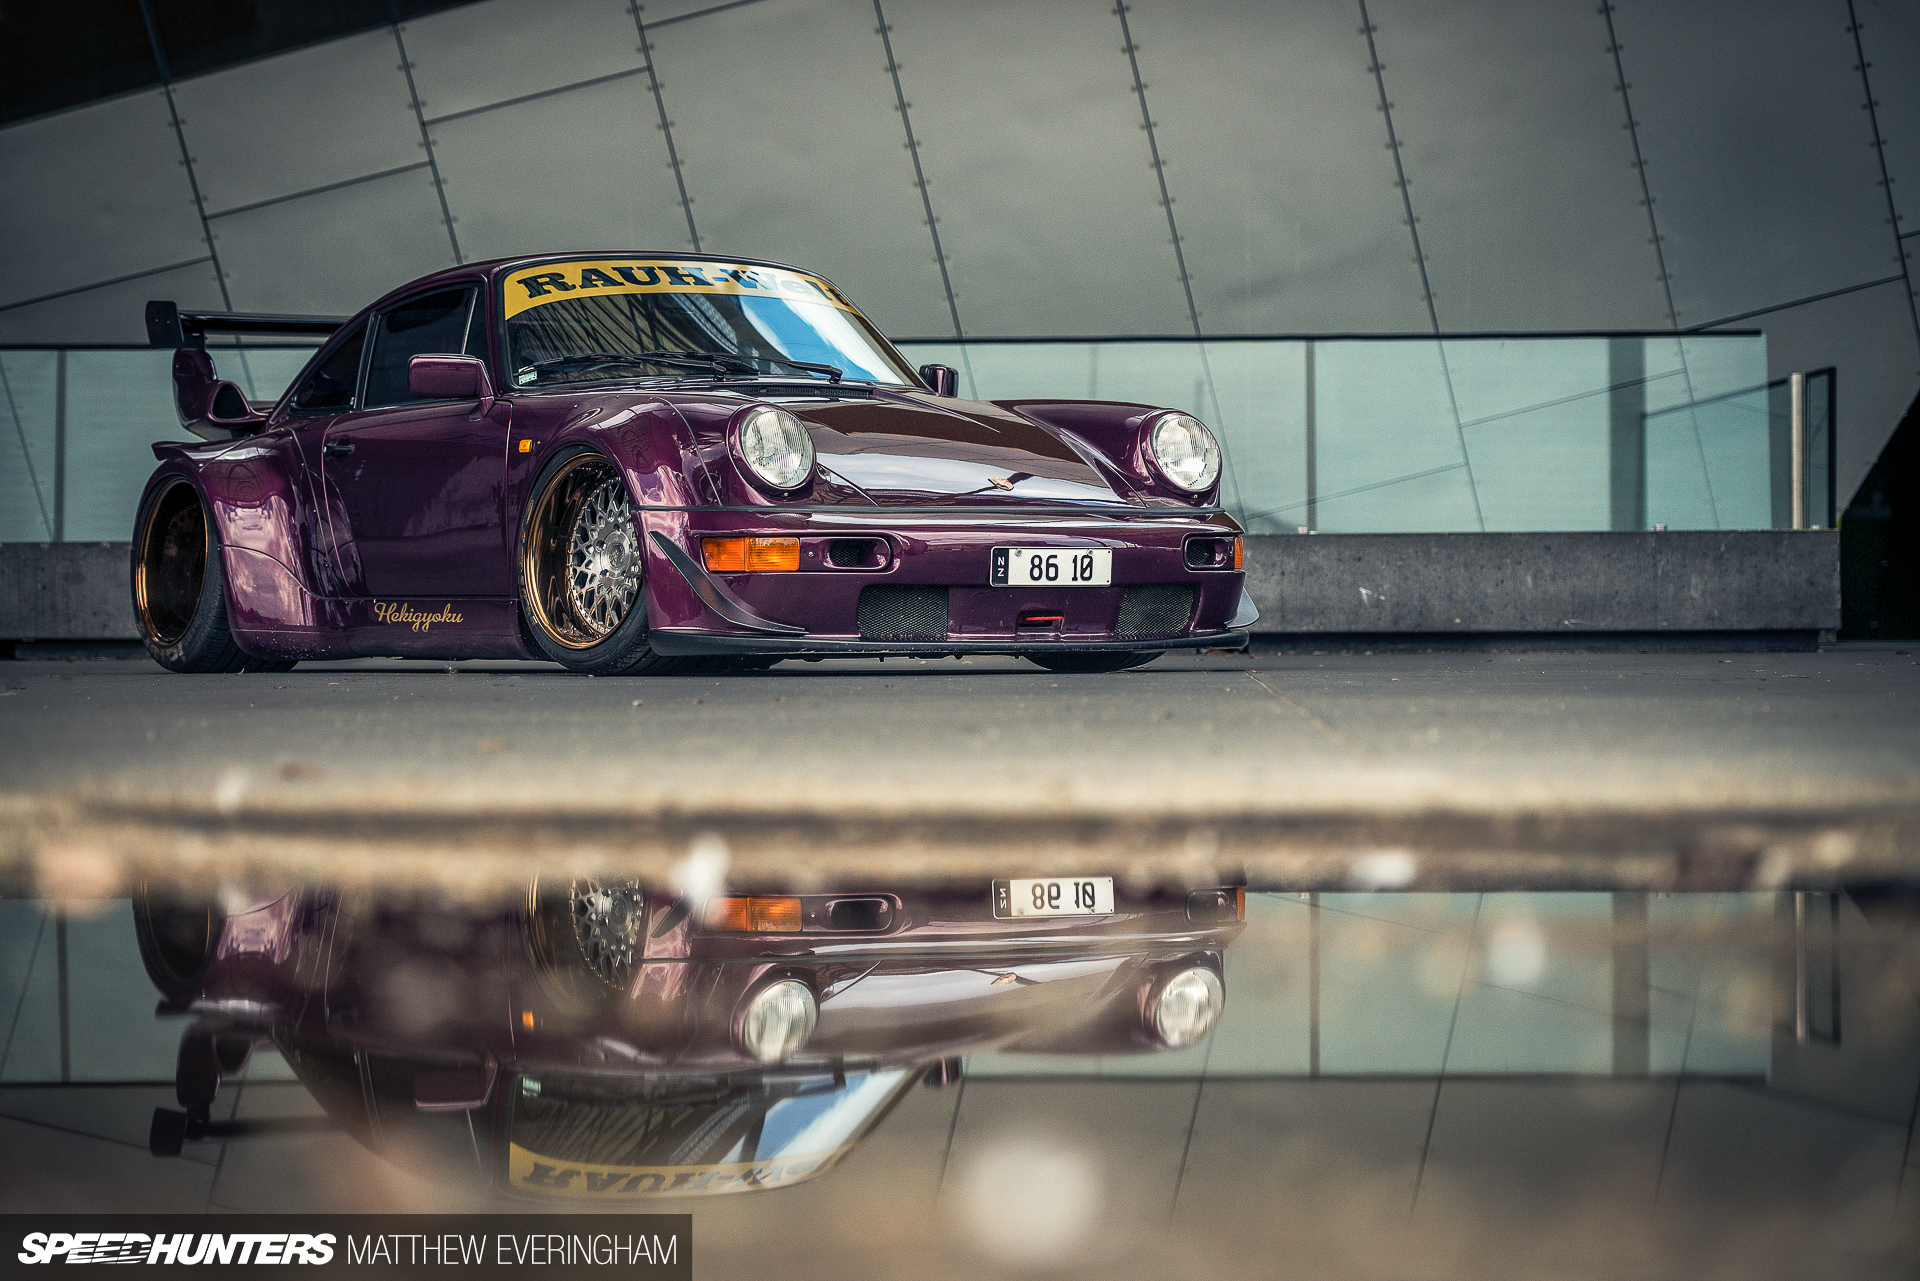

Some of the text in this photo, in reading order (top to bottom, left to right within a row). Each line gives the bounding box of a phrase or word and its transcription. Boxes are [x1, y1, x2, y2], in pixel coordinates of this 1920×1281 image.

[997, 556, 1005, 577] NZ
[1030, 555, 1093, 581] 86 10
[374, 602, 464, 632] Hekigyoku
